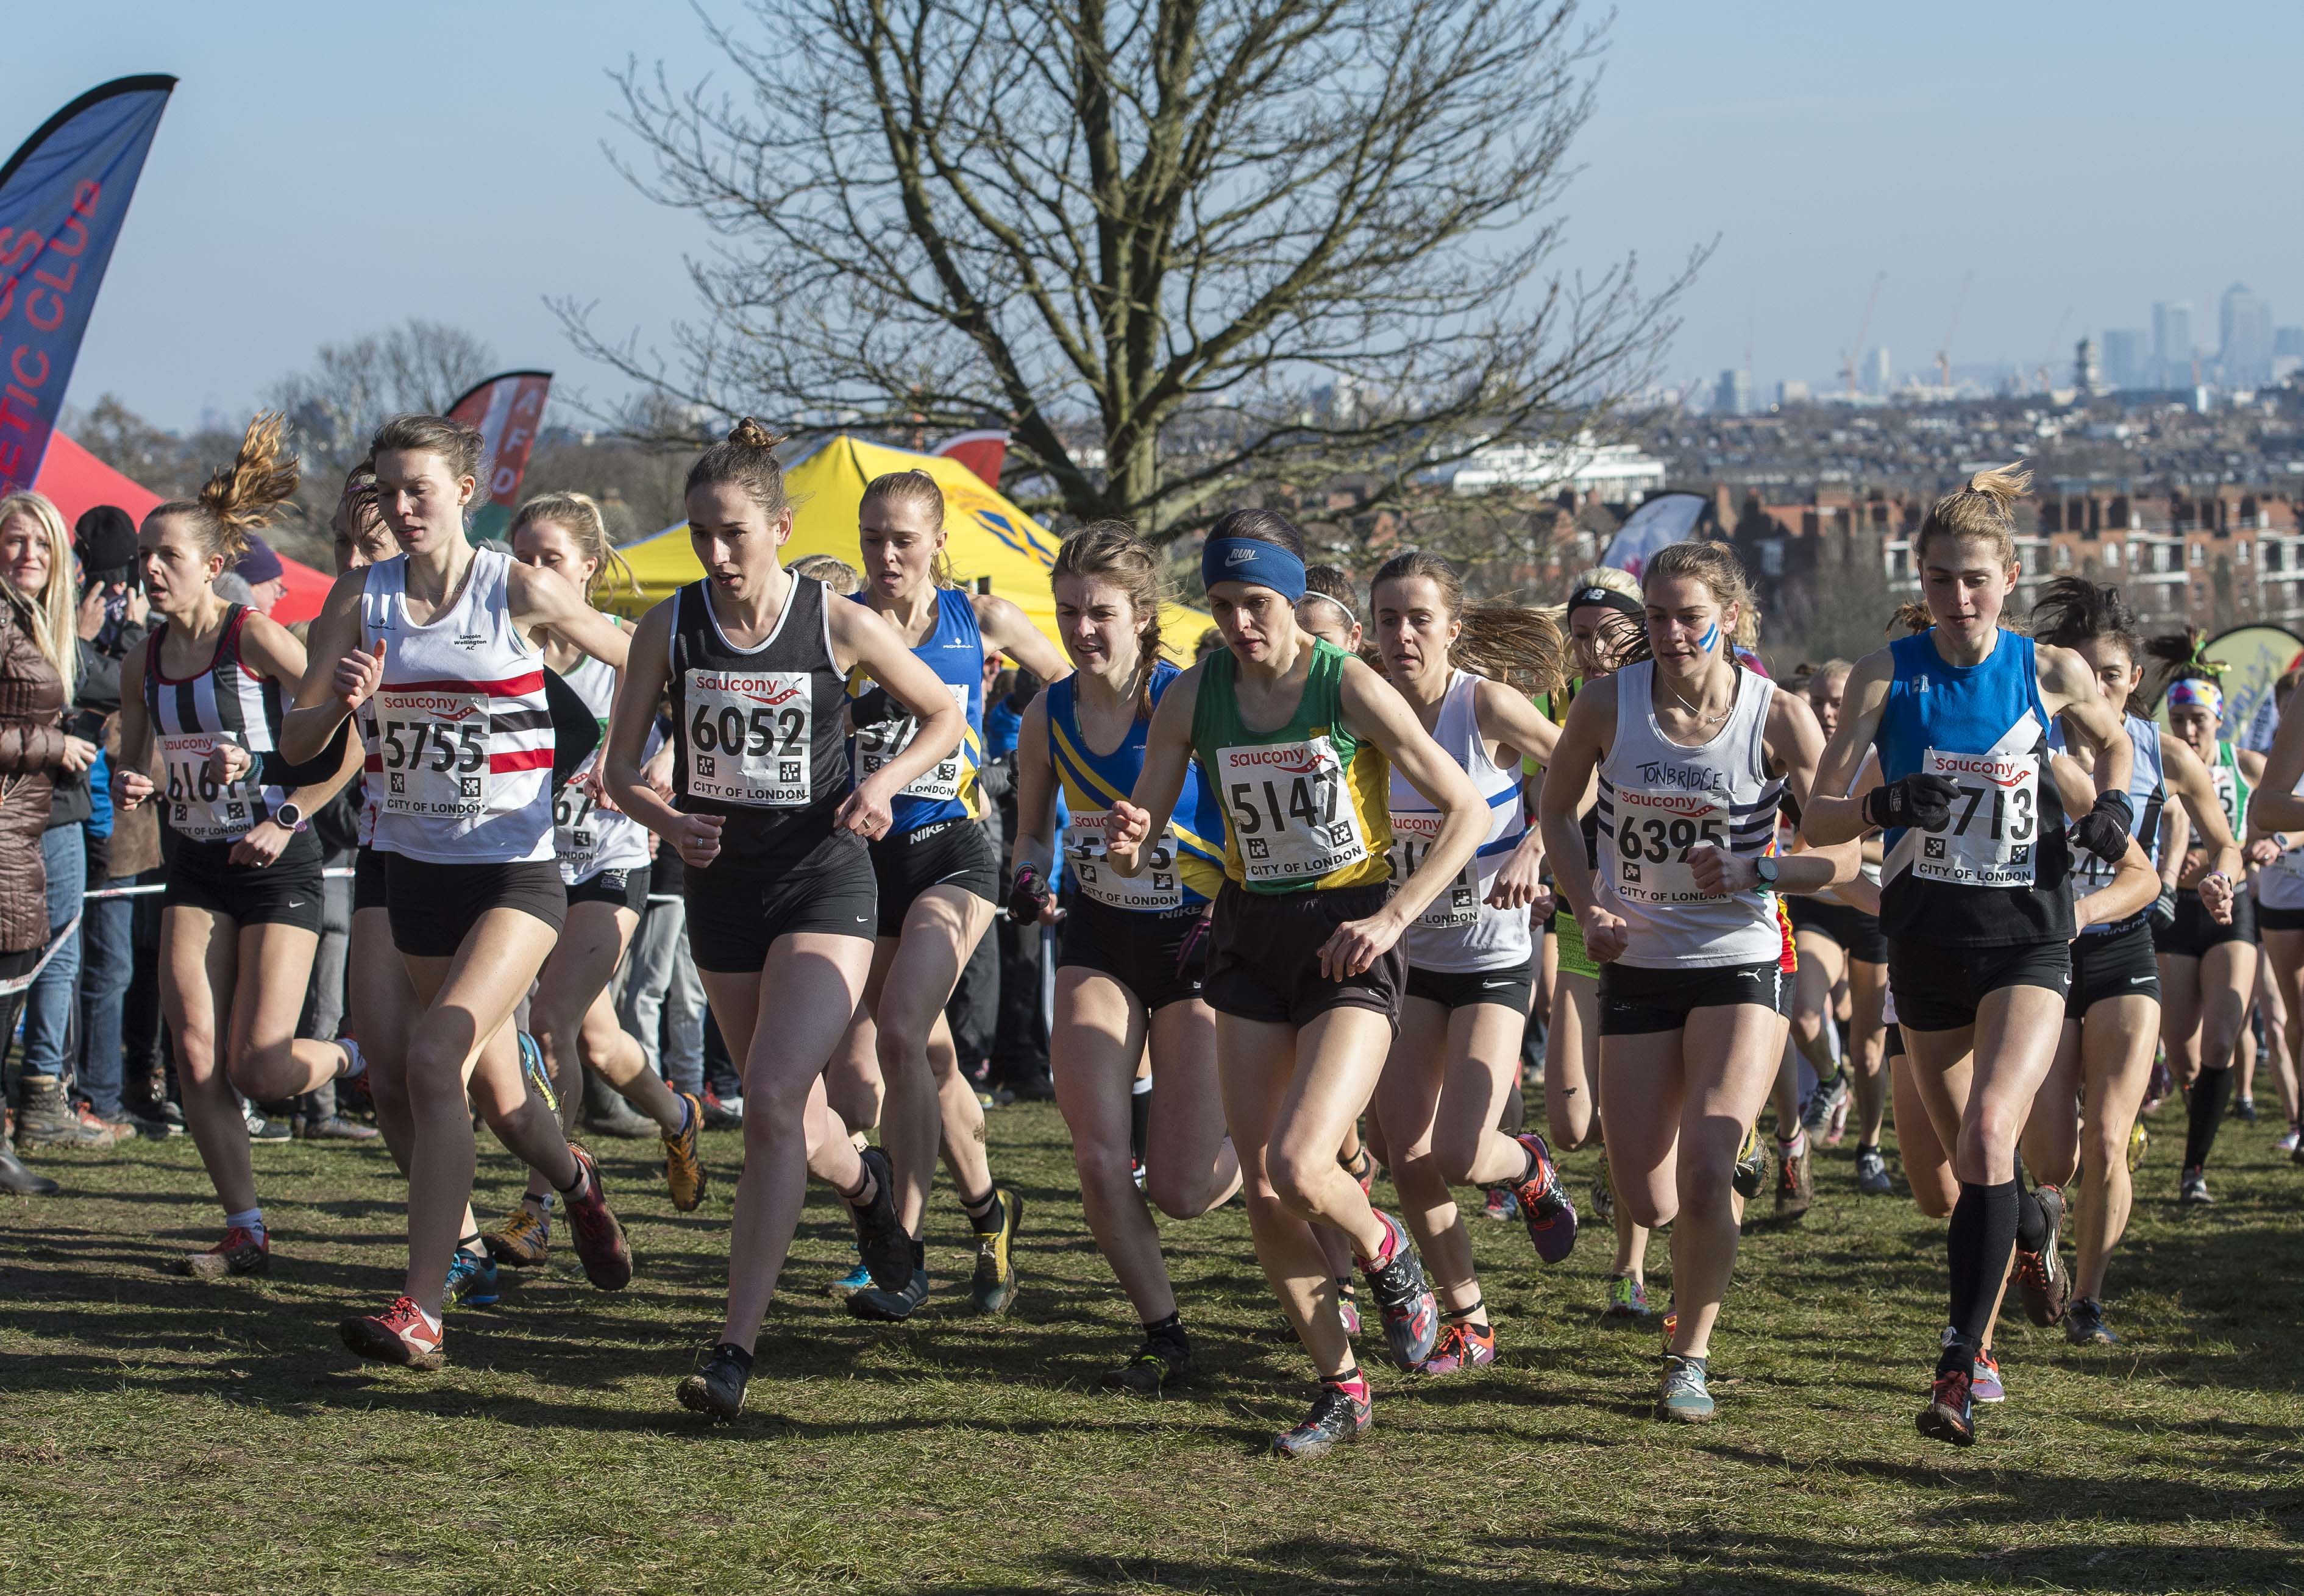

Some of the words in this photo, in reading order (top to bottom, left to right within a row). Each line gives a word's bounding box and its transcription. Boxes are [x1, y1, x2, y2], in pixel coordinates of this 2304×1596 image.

[0, 344, 50, 497] ETIC
[25, 179, 101, 332] CLUB
[1230, 548, 1256, 559] RUN
[696, 676, 778, 695] saucony
[385, 697, 457, 711] saucony
[691, 704, 805, 756] 6052
[165, 737, 213, 750] saucony
[385, 721, 484, 773] 5755
[1229, 748, 1305, 767] saucony
[1635, 761, 1723, 792] TONBRIDGE
[1935, 757, 2015, 778] saucony
[693, 781, 722, 795] CITY
[725, 787, 742, 796] OF
[747, 789, 806, 800] LONDON
[908, 784, 955, 796] LONDON
[1231, 765, 1339, 834] 5147
[387, 798, 411, 809] CITY
[413, 802, 427, 812] OF
[1622, 791, 1698, 810] saucony
[208, 823, 251, 835] LONDON
[910, 823, 945, 845] NIKE
[1618, 815, 1725, 864] 6395
[555, 850, 593, 860] ONDON
[1251, 863, 1279, 876] CITY
[1284, 862, 1300, 873] OF
[1306, 846, 1362, 871] LONDON
[1919, 863, 1950, 877] CITY
[1954, 868, 1973, 879] OF
[1977, 871, 2031, 882] LONDON
[1083, 884, 1103, 899] CITY
[1106, 892, 1120, 903] OF
[1124, 895, 1179, 906] LONDON
[1620, 885, 1647, 899] CITY
[1651, 892, 1668, 901] OF
[1159, 906, 1201, 920] NIKE
[1425, 912, 1477, 923] LONDON
